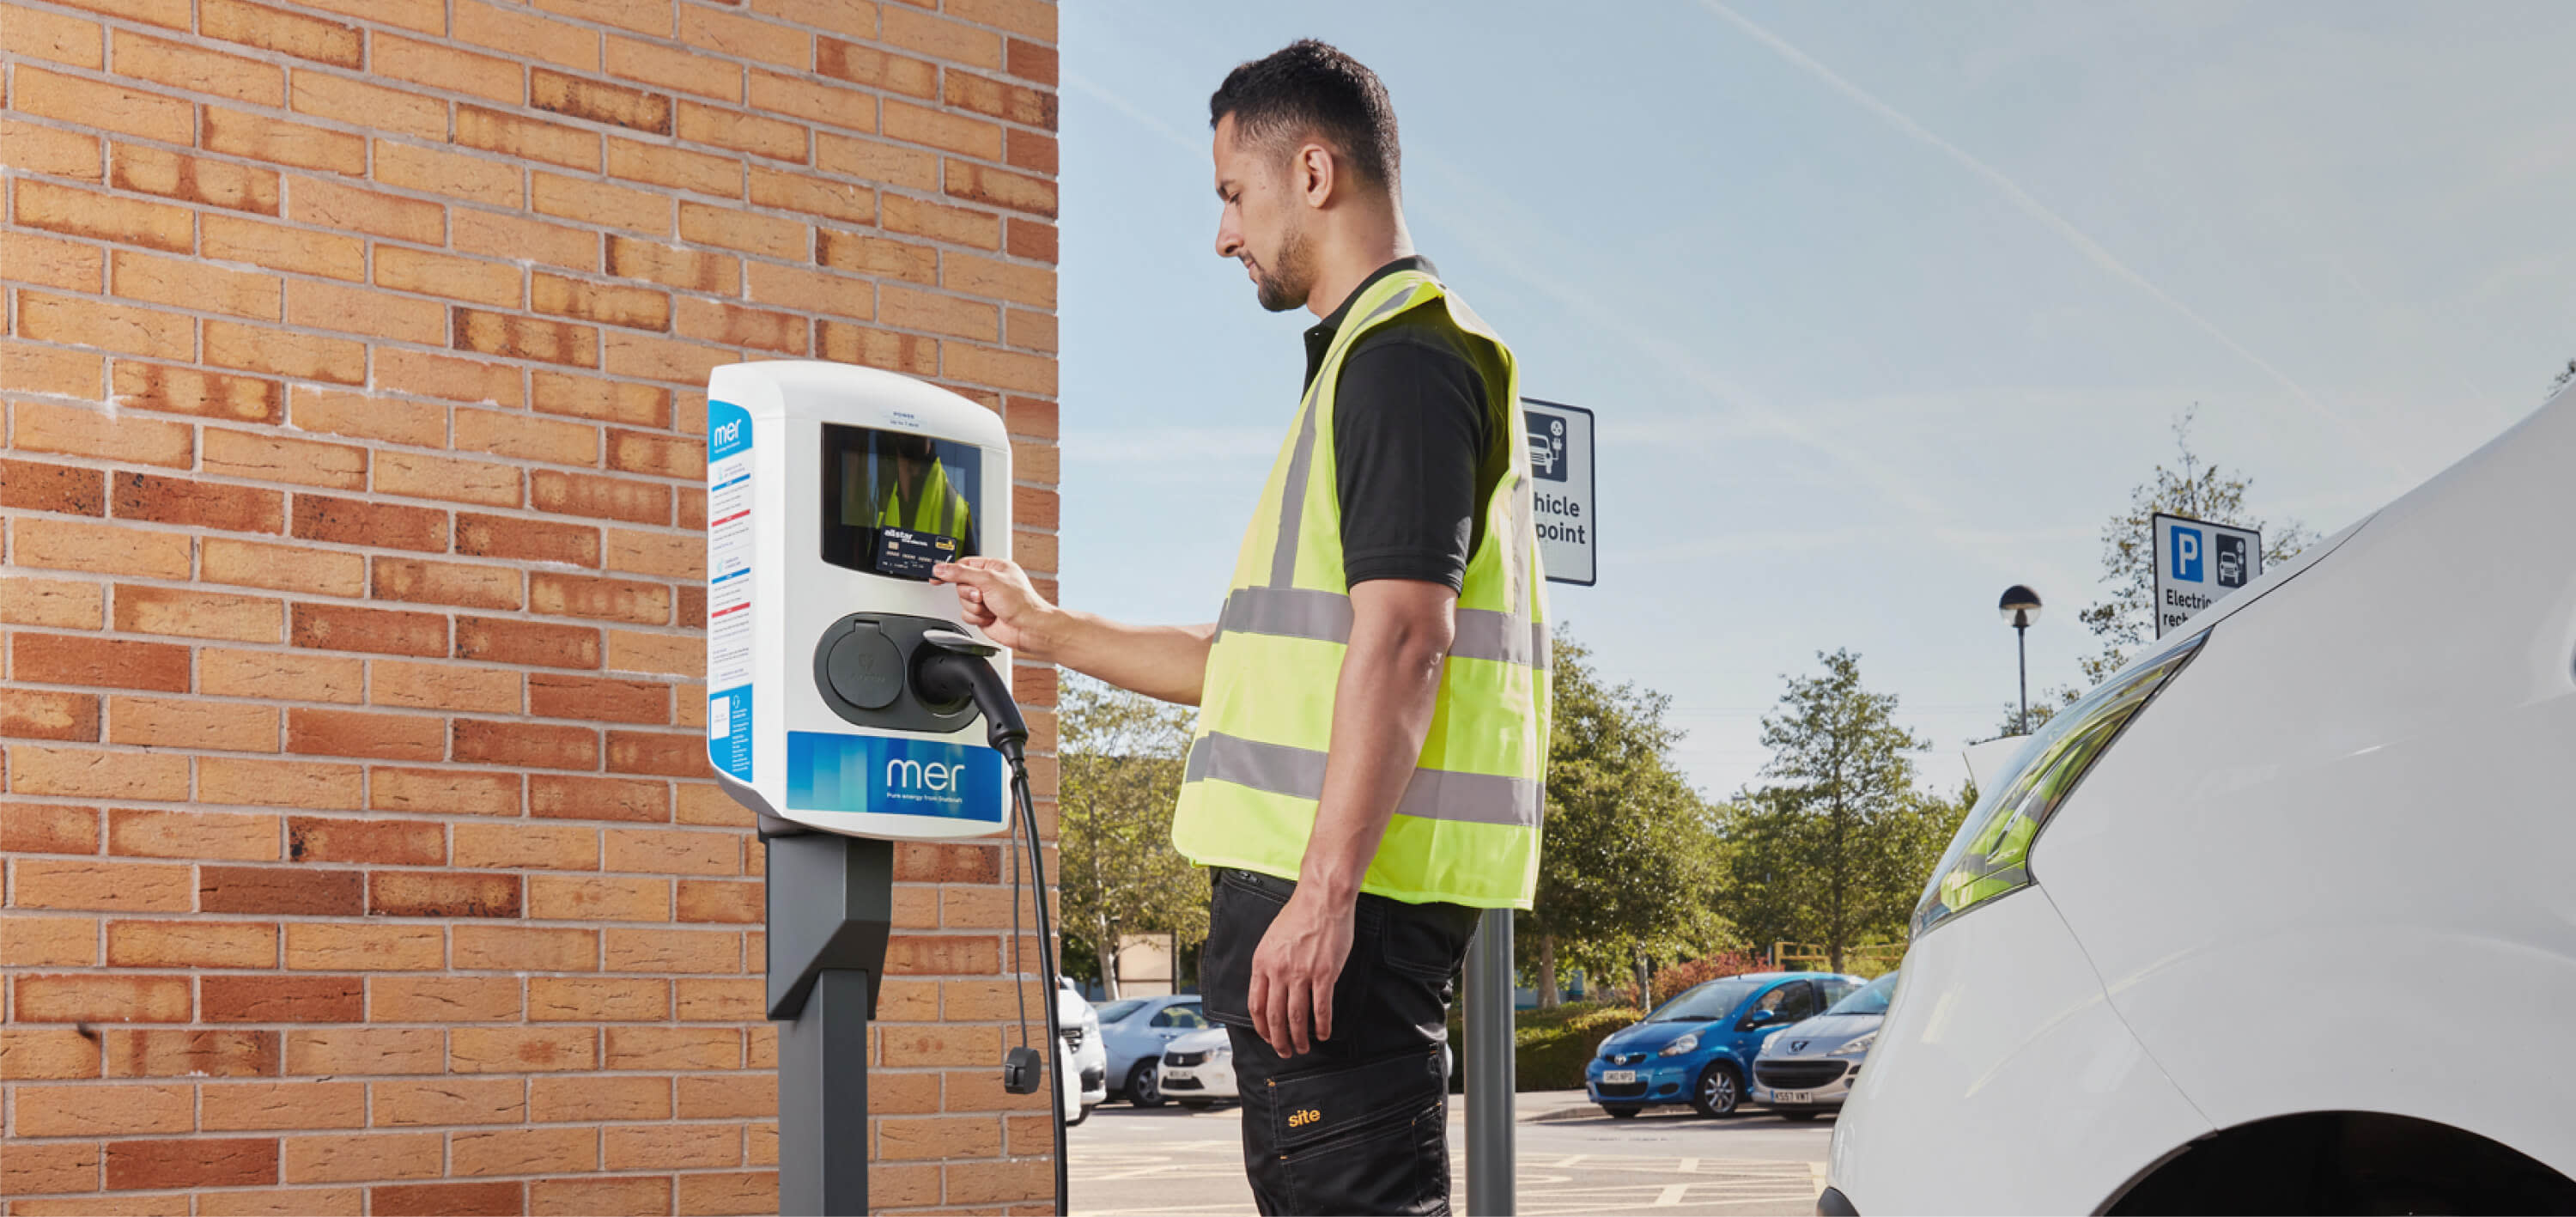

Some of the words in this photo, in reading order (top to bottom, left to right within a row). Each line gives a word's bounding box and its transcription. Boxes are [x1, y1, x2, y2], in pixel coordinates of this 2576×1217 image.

[714, 419, 742, 447] mer
[1534, 491, 1581, 518] hicle
[1535, 521, 1586, 545] point
[2178, 532, 2198, 575] P
[886, 759, 966, 792] mer
[1289, 1109, 1321, 1128] site
